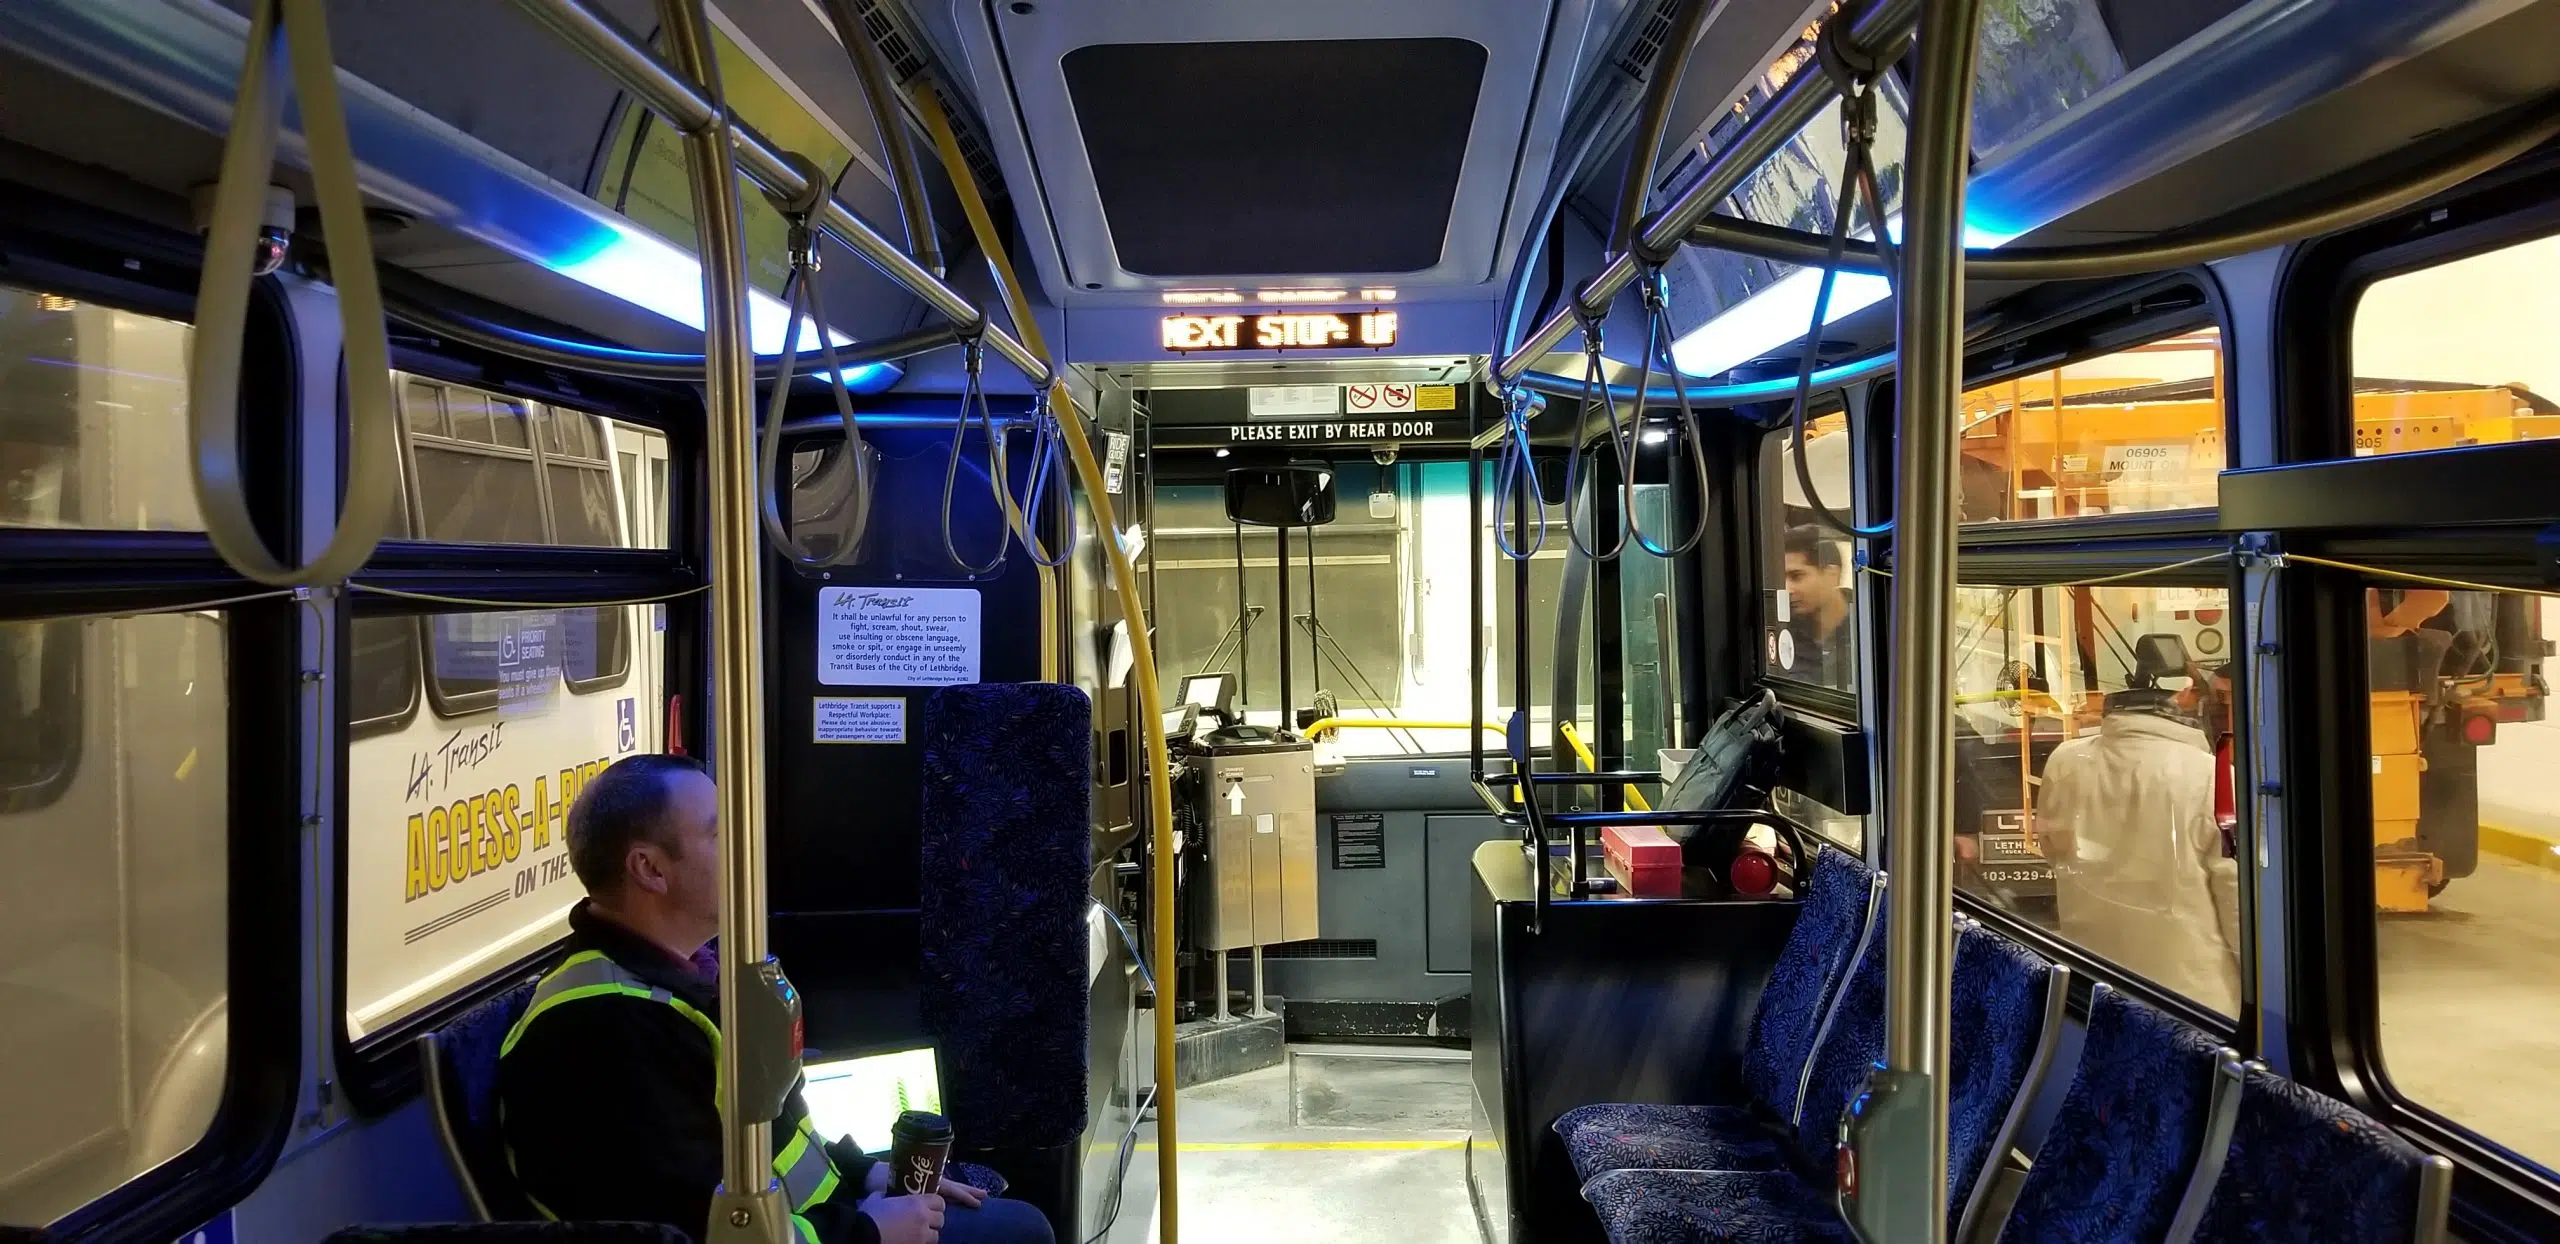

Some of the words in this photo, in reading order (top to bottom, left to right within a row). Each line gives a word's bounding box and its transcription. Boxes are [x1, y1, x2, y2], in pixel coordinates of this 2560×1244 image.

[1162, 316, 1244, 347] NEXT
[1231, 425, 1282, 440] PLEASE
[1289, 425, 1318, 439] EXIT
[1325, 424, 1343, 438] BY
[1350, 423, 1385, 438] REAR
[1393, 422, 1433, 436] DOOR
[1110, 436, 1127, 450] RIDE
[1108, 450, 1125, 460] GUIDE
[2126, 448, 2167, 458] 06905
[2110, 461, 2155, 470] MOUNT
[858, 593, 914, 610] Transit
[851, 623, 868, 632] fight,
[522, 630, 546, 643] PRIORITY
[854, 633, 882, 641] insulting
[927, 635, 960, 643] language,
[522, 645, 544, 659] SEATING
[897, 645, 922, 653] engage
[934, 644, 966, 653] unseemly
[846, 653, 880, 662] disorderly
[889, 663, 900, 671] the
[903, 664, 916, 672] City
[930, 664, 968, 673] Lethbridge.
[437, 721, 505, 791] Transit
[405, 756, 610, 903] ACCESS-A-R
[514, 865, 537, 899] ON
[542, 853, 569, 887] THE
